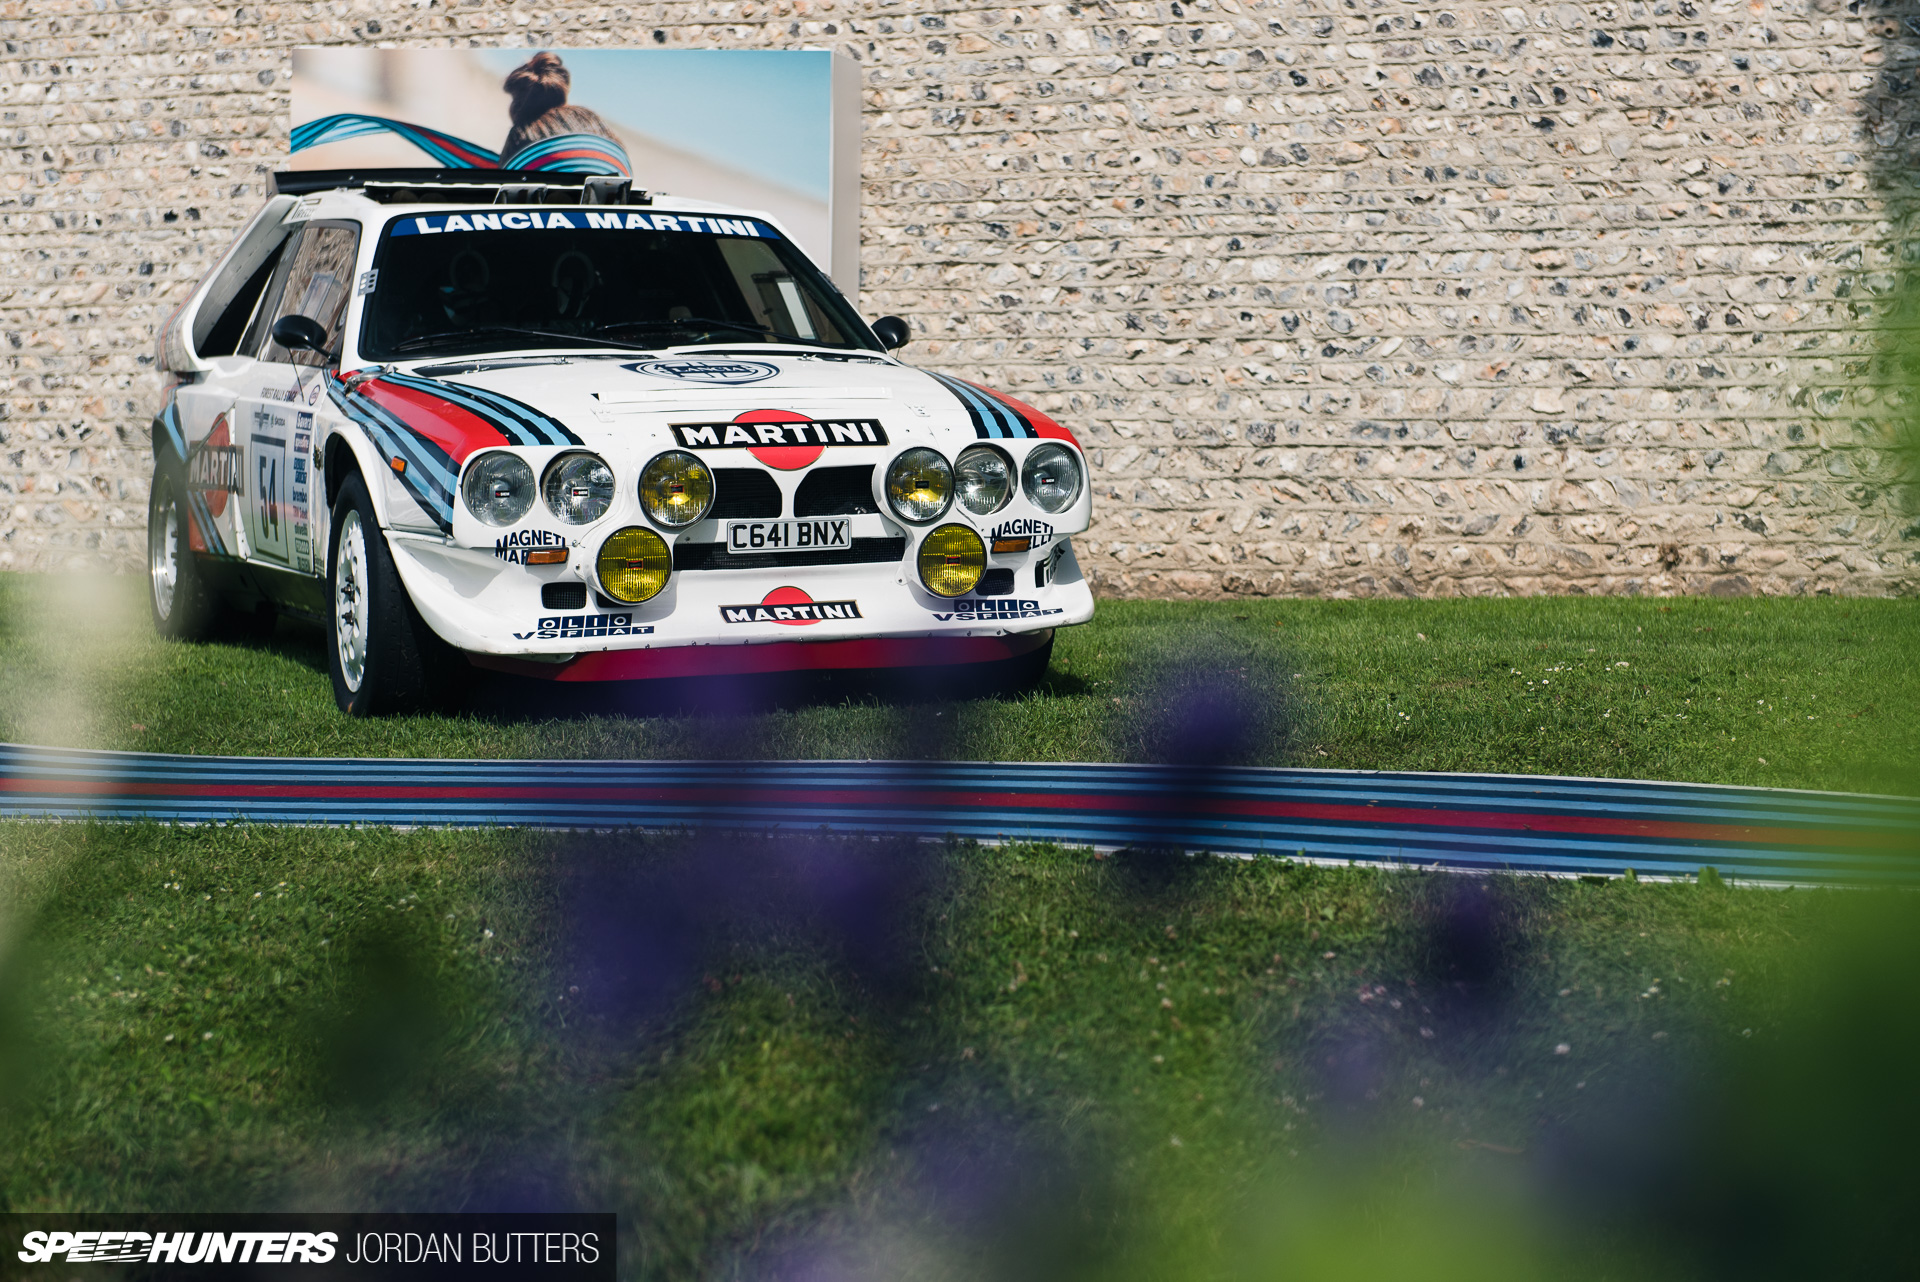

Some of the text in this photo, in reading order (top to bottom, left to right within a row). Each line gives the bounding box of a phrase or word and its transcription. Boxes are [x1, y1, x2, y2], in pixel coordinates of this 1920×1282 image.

[415, 212, 760, 237] LANCIA MARTINI
[680, 422, 878, 446] MARTINI
[190, 450, 243, 489] MARTINI
[259, 455, 279, 542] 54
[495, 529, 566, 549] MAGNETI
[732, 520, 845, 549] C641 BNX
[991, 518, 1054, 540] MAGNETI
[726, 604, 856, 622] MARTINI
[958, 601, 1035, 611] OLIO
[541, 615, 628, 629] OLIO
